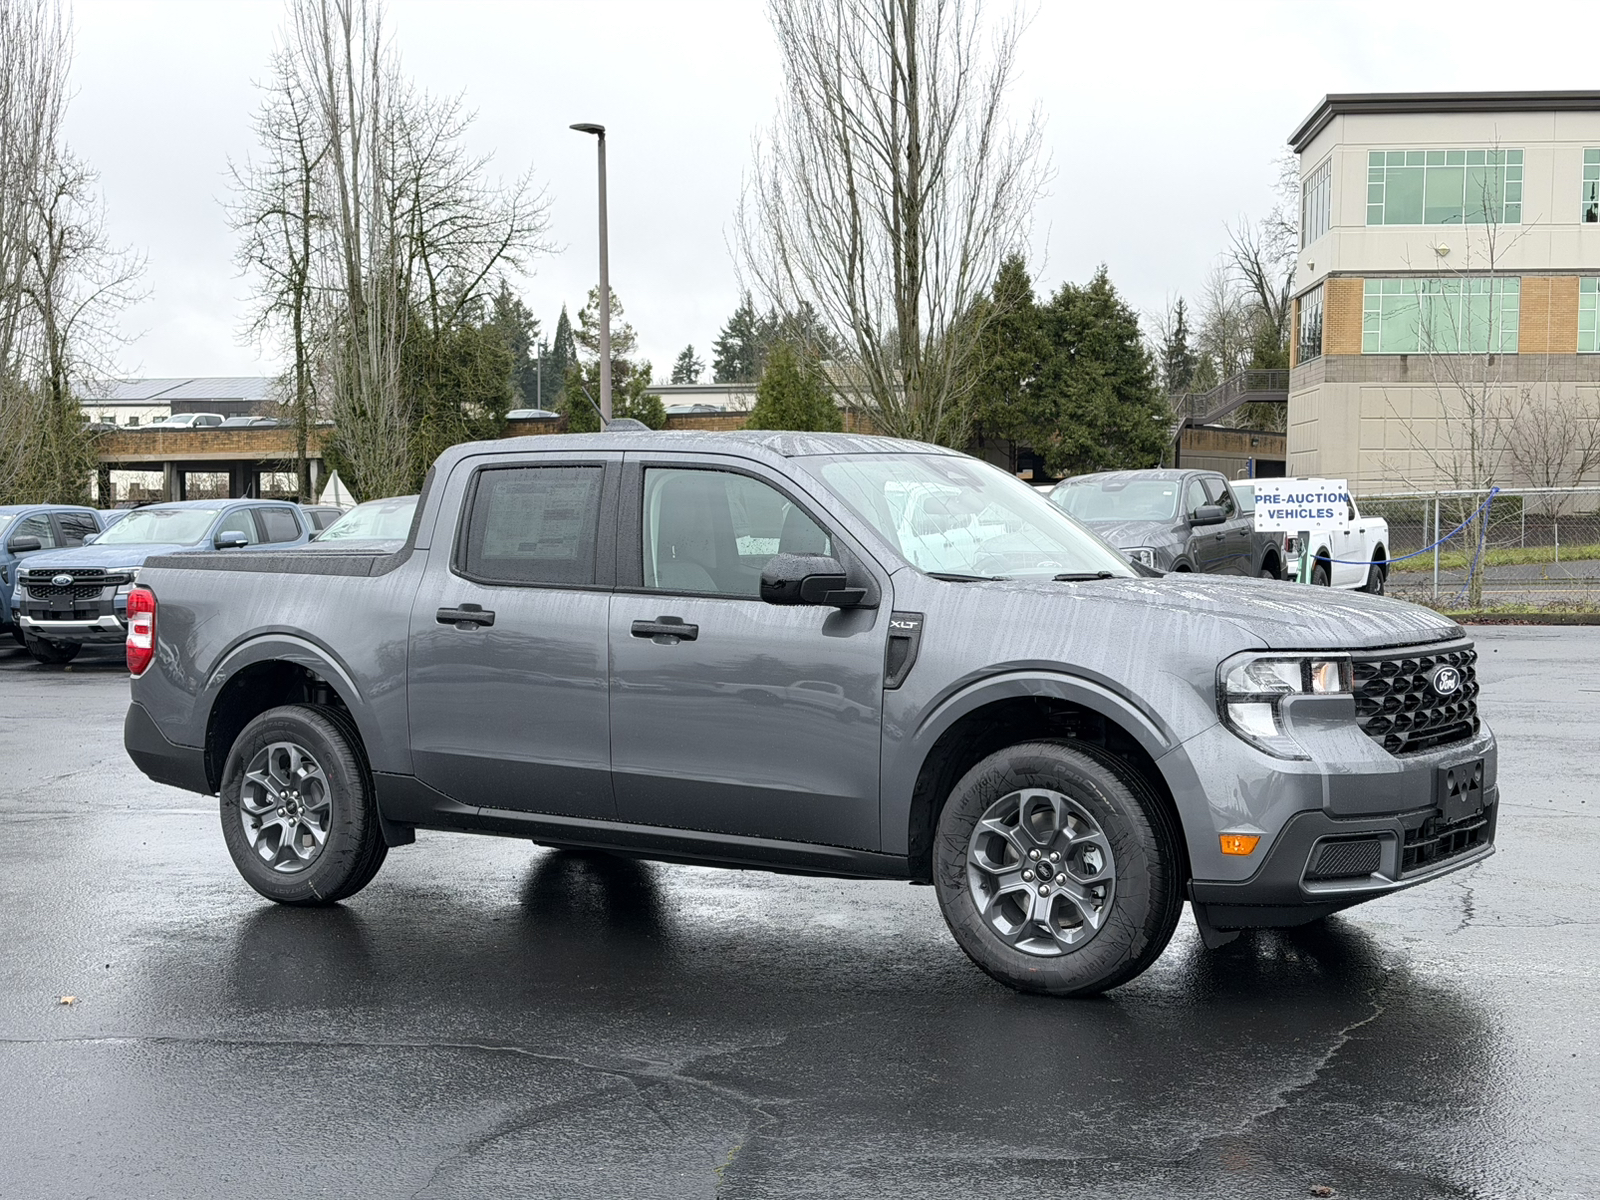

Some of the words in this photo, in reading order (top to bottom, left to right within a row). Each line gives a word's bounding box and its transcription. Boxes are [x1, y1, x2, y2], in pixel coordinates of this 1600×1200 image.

[1255, 492, 1348, 504] PRE-AUCTION
[1267, 508, 1334, 519] VEHICLES
[890, 620, 919, 629] XLT
